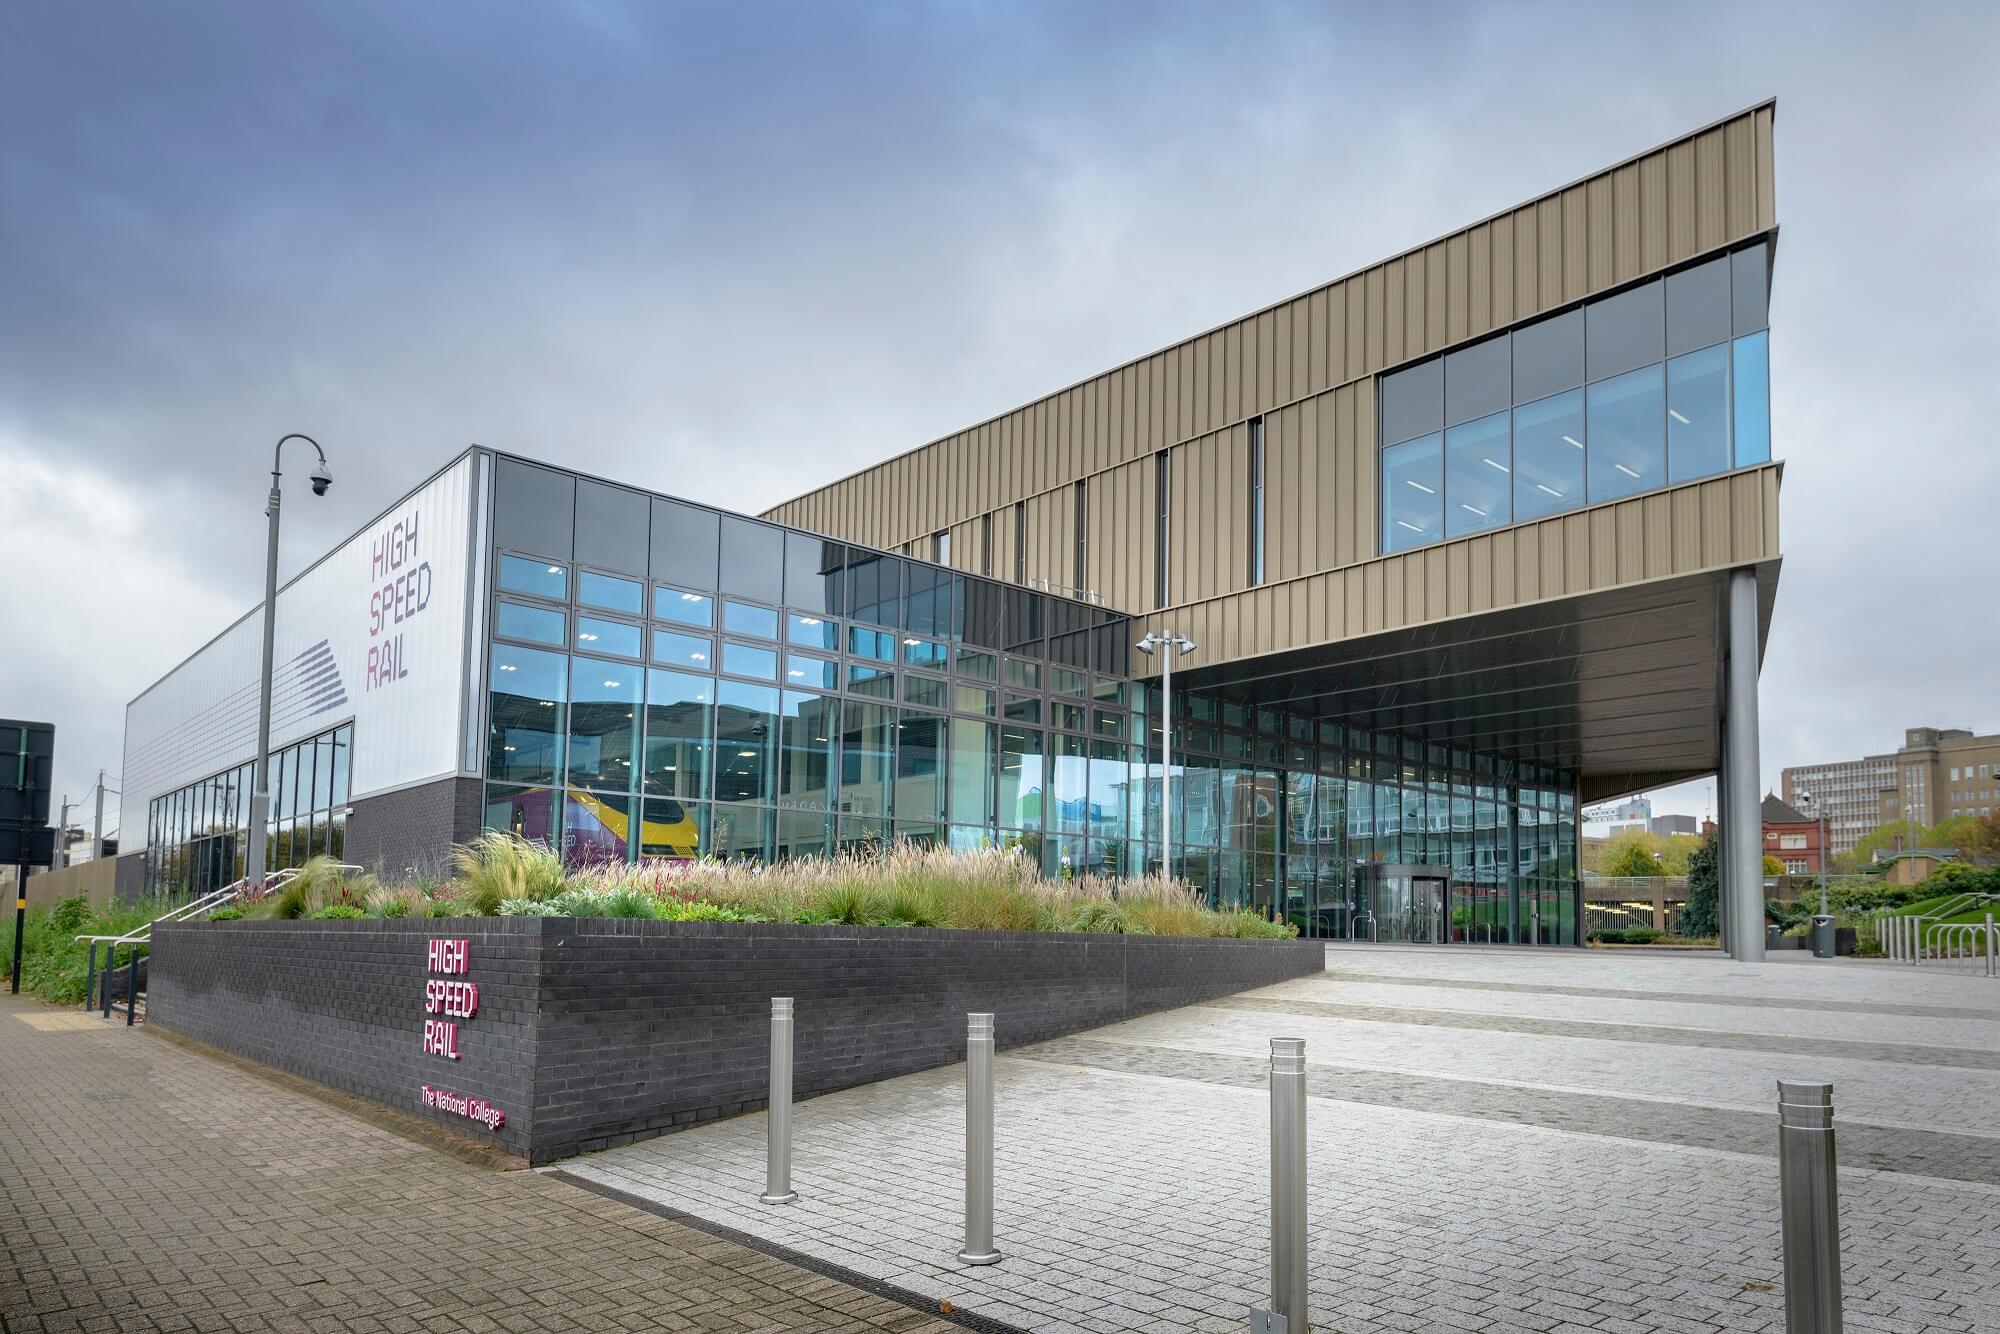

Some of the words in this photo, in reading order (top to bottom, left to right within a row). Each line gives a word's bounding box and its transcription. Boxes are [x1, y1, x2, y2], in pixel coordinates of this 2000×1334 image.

[371, 510, 419, 583] HIGH
[369, 561, 432, 637] SPEED
[366, 633, 408, 693] RAIL
[428, 939, 468, 975] HIGH
[425, 979, 477, 1018] SPEED
[423, 1019, 460, 1060] RAIL
[421, 1085, 435, 1106] The
[435, 1090, 469, 1117] National
[469, 1099, 503, 1131] College
